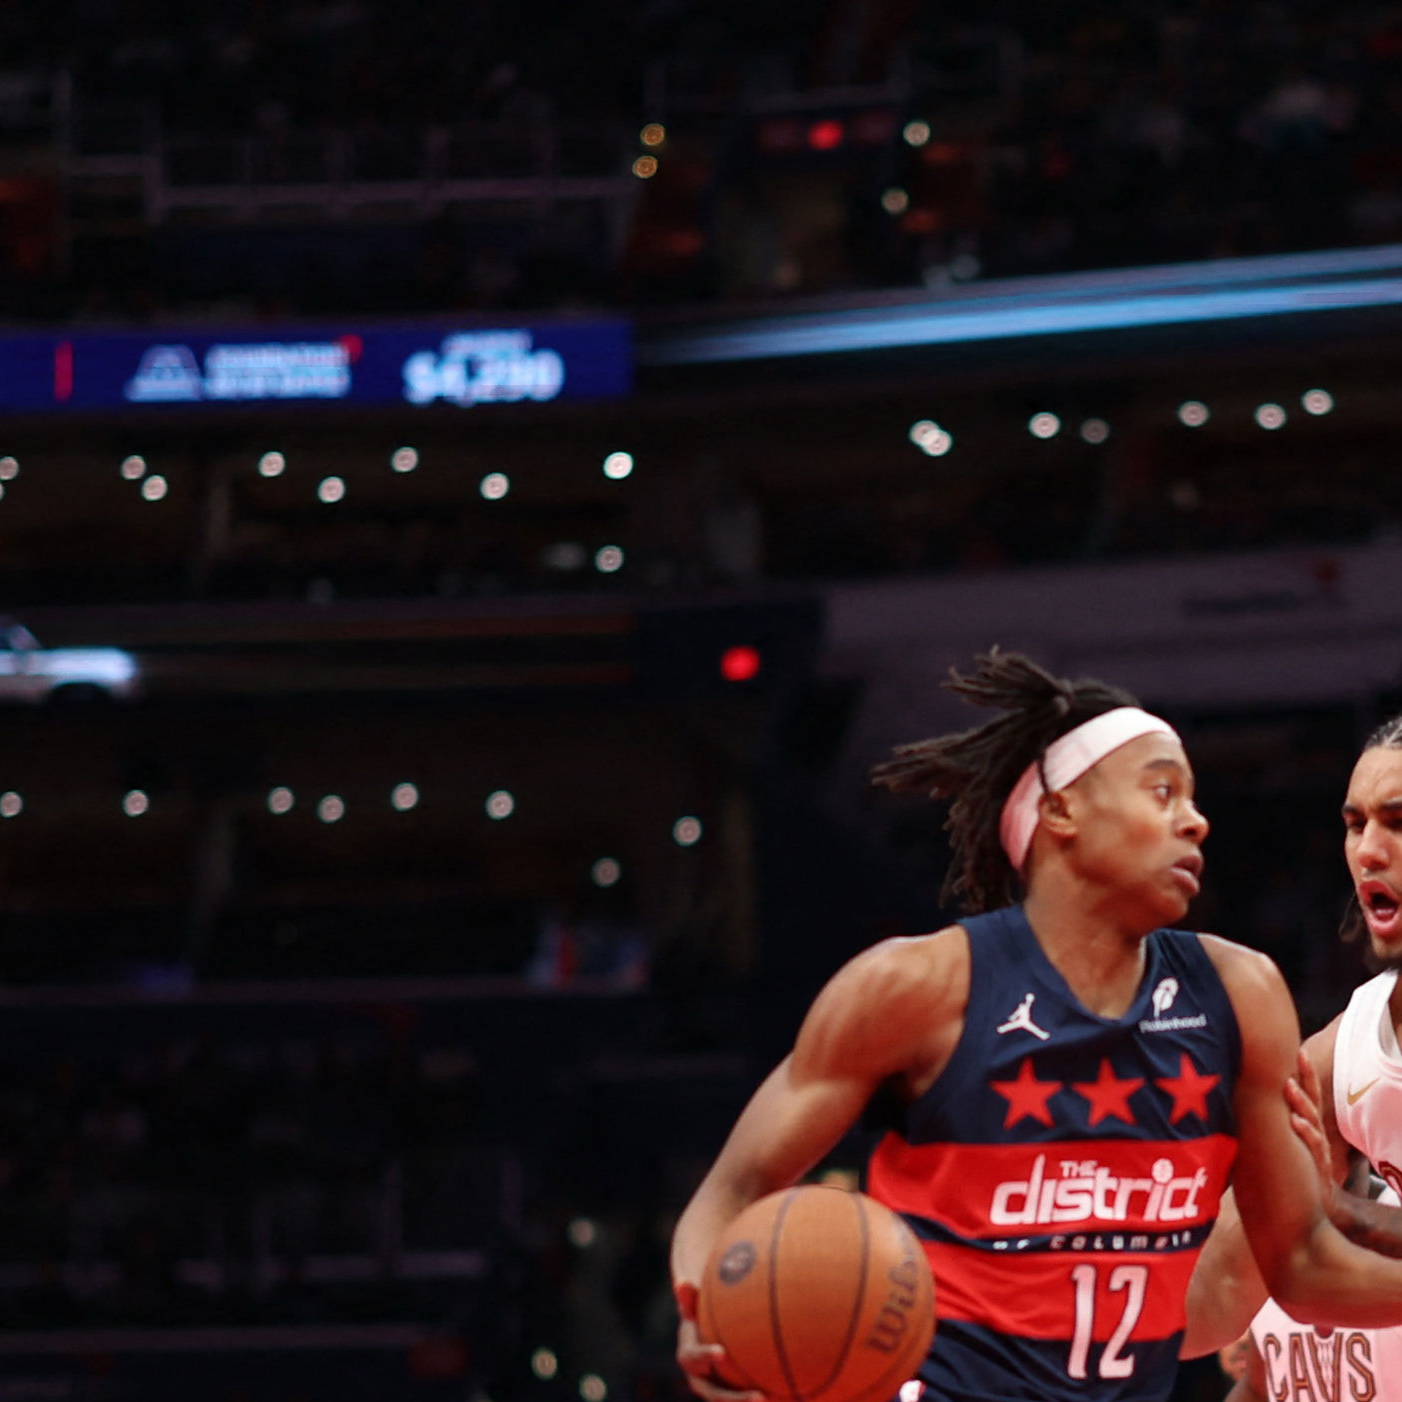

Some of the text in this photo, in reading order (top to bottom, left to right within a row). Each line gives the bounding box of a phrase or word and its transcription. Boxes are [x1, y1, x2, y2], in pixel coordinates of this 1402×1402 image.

[1139, 1013, 1207, 1034] Robinhood
[989, 1153, 1208, 1225] district
[1060, 1160, 1099, 1178] THE
[1067, 1263, 1148, 1380] 12
